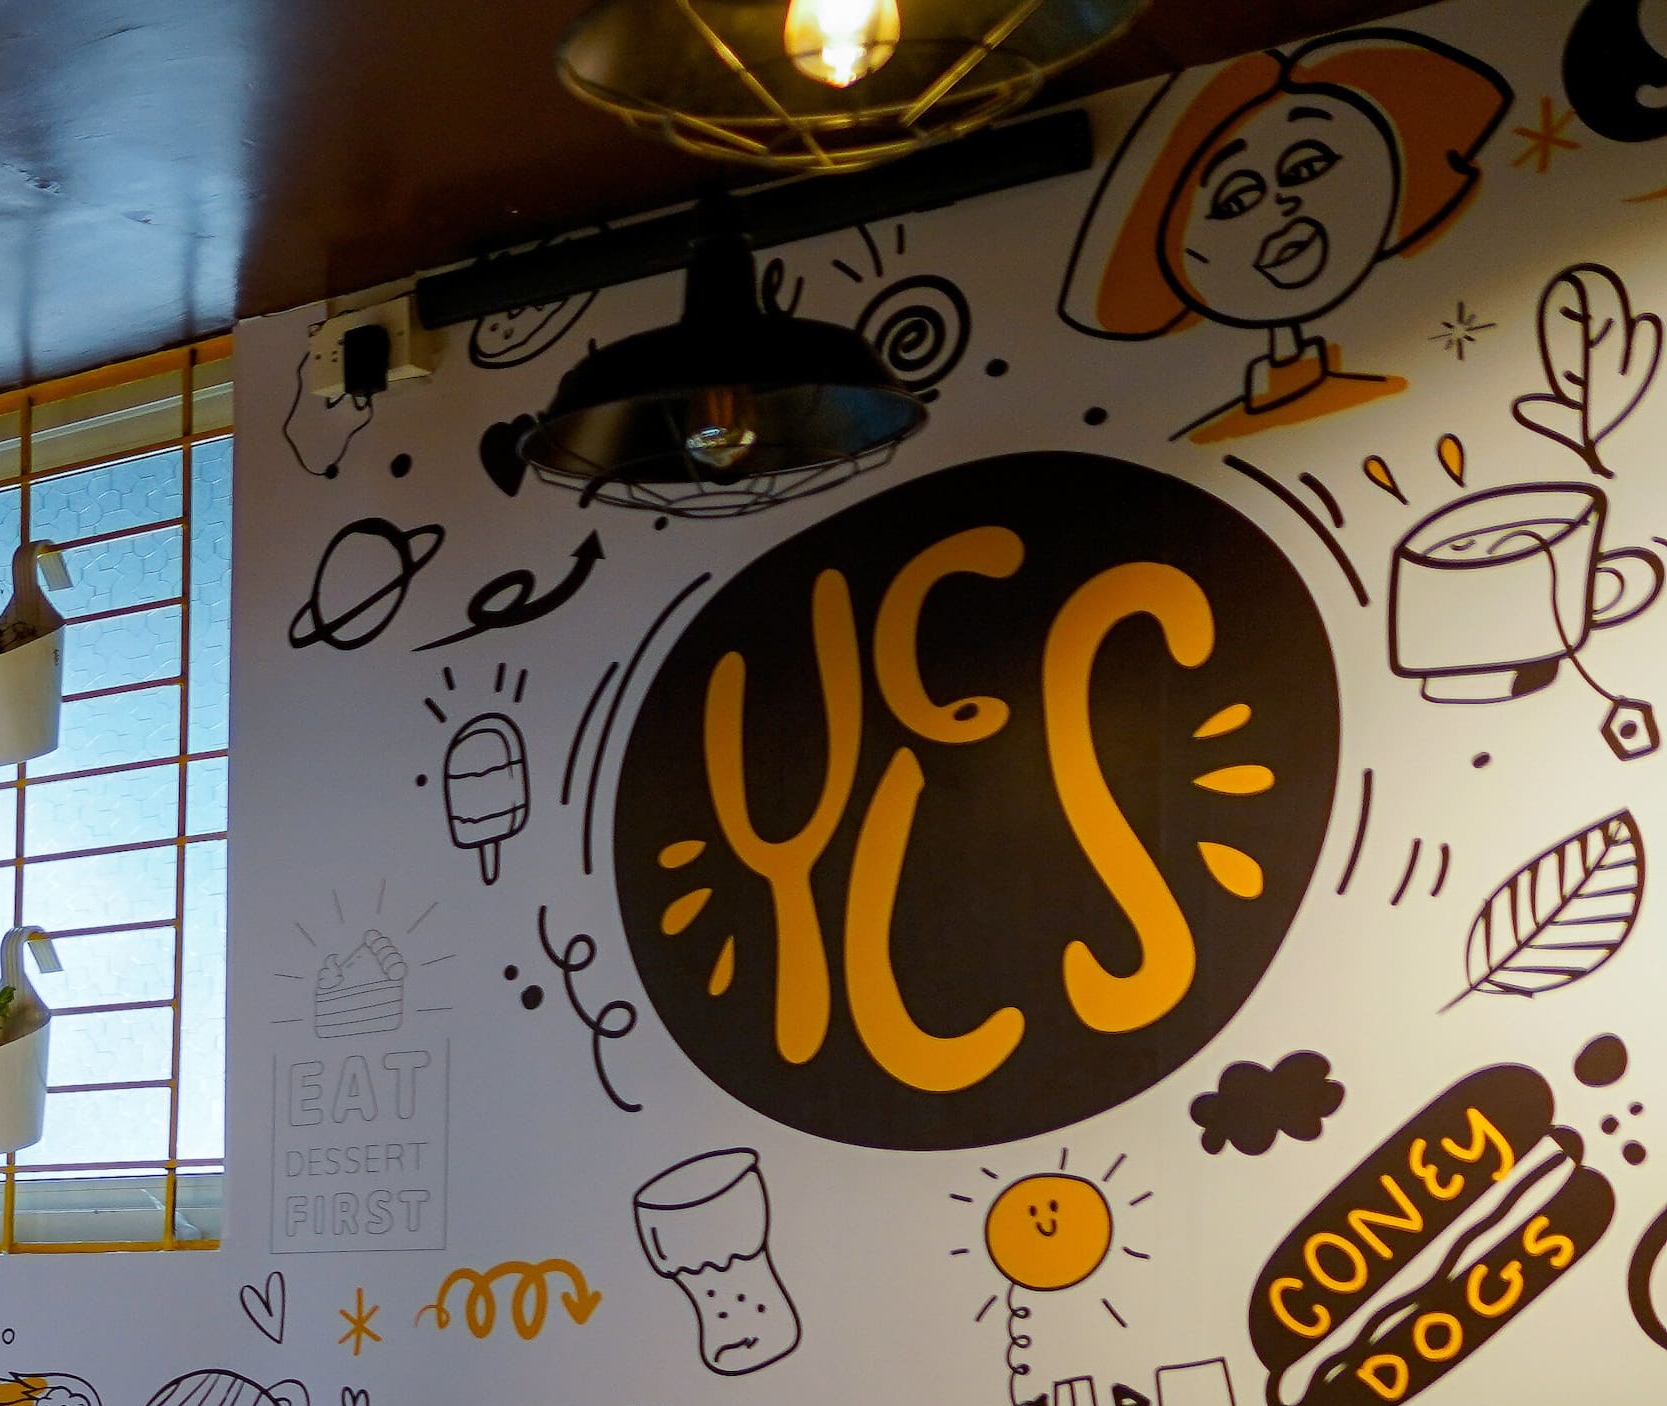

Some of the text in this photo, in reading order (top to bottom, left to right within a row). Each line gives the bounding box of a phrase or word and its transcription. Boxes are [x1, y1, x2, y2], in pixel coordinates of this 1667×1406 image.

[704, 526, 1215, 1093] YES
[287, 1049, 432, 1128] EAT
[284, 1141, 429, 1178] DESSERT
[284, 1189, 431, 1237] FIRST
[1267, 1108, 1515, 1338] CONEY
[1357, 1216, 1575, 1398] DOGS
